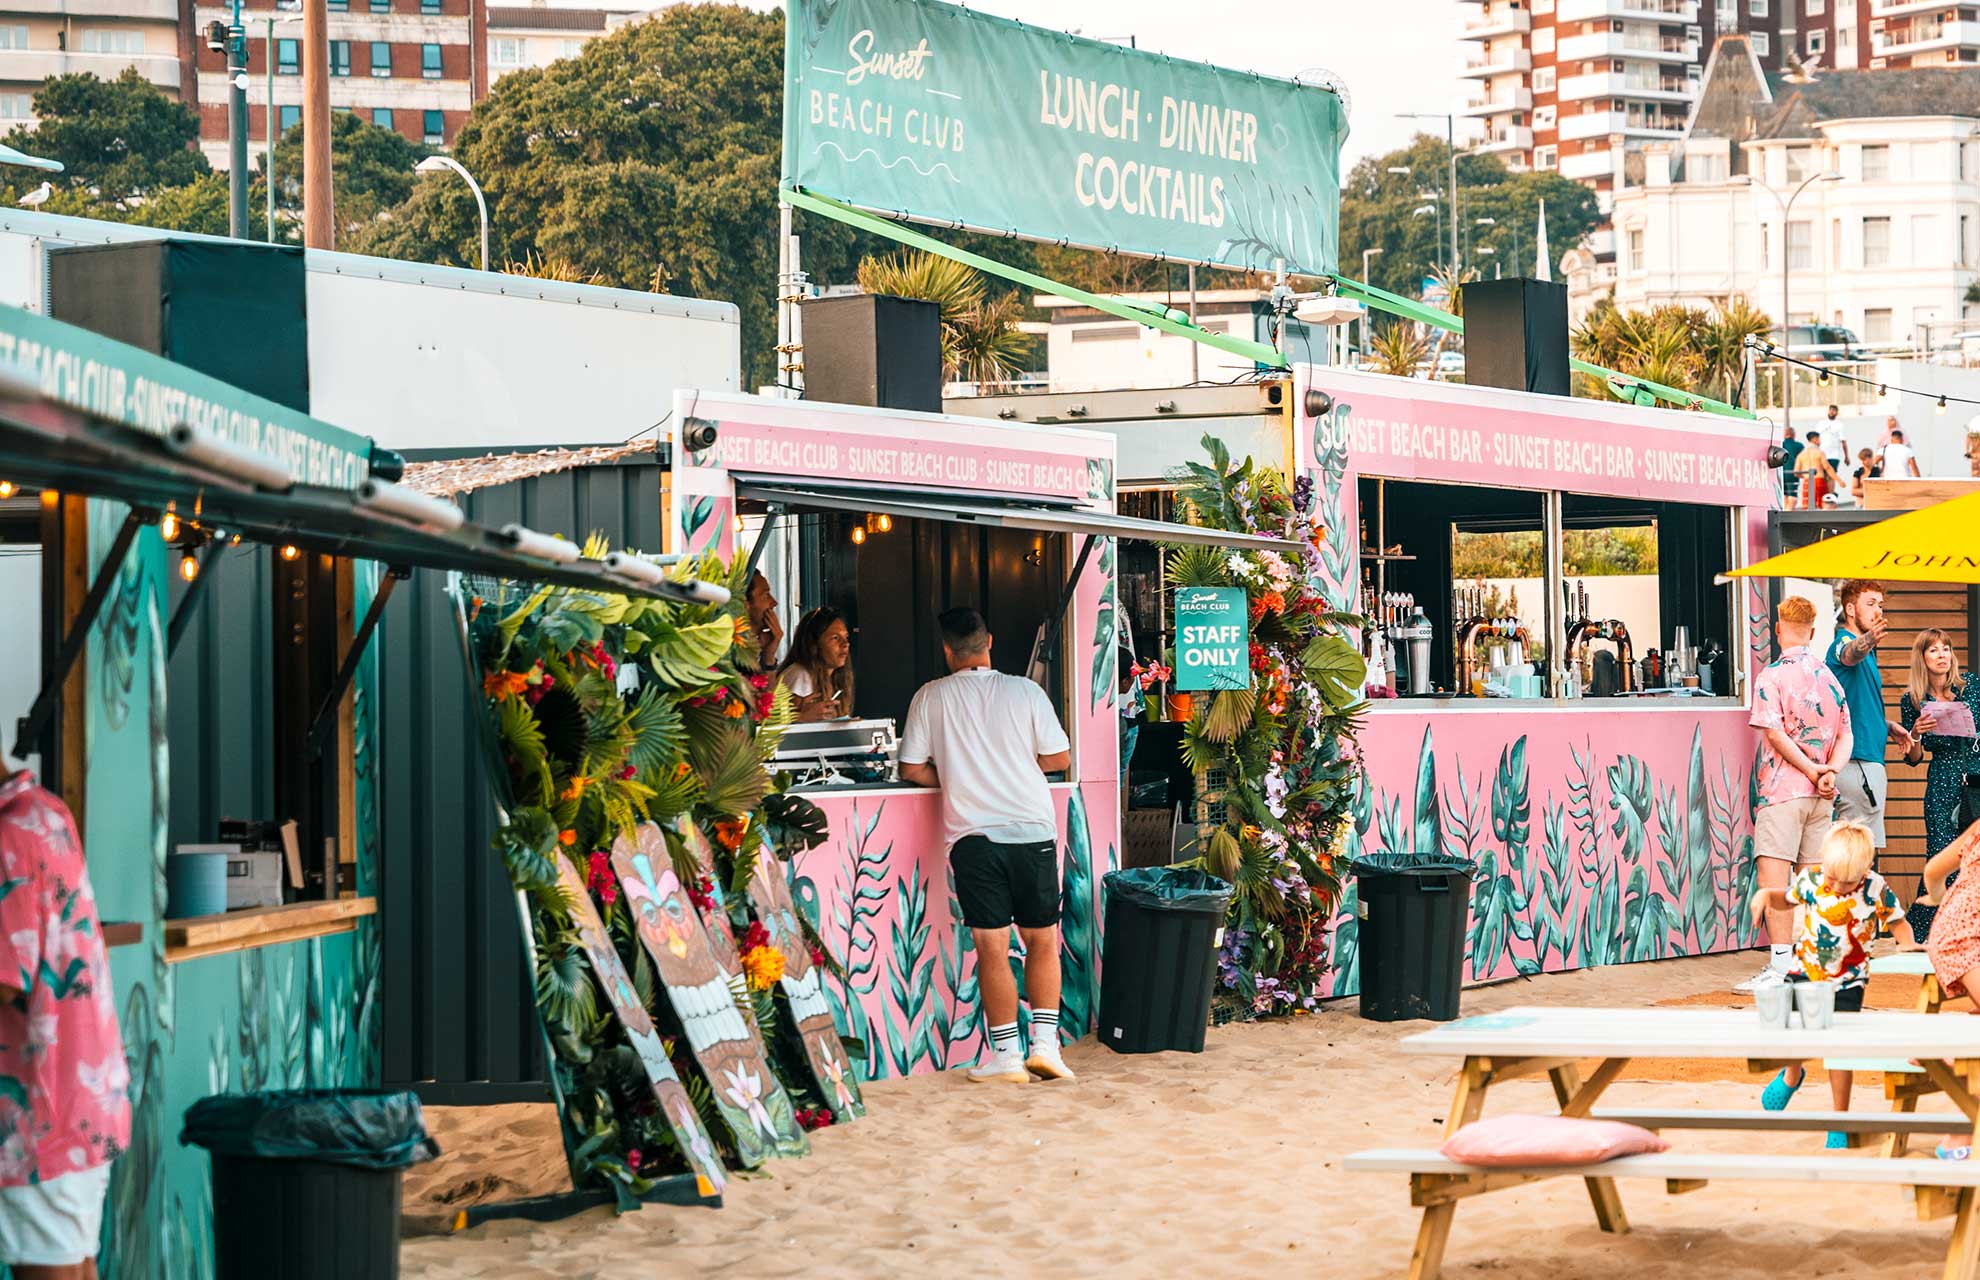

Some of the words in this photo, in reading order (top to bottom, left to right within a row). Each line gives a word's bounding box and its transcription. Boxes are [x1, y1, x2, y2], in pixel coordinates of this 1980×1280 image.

[846, 29, 934, 87] Sunset
[809, 90, 893, 139] BEACH
[904, 108, 965, 153] CLUB
[1040, 70, 1139, 143] LUNCH
[1158, 96, 1258, 165] DINNER
[1074, 152, 1225, 230] COCKTAILS
[754, 438, 800, 467] BEACH
[802, 443, 839, 470] CLUB
[848, 447, 898, 475] SUNSET
[901, 451, 943, 479] BEACH
[946, 455, 978, 482] CLUB
[986, 459, 1031, 486] SUNSET
[1033, 464, 1073, 491] BEACH
[1318, 414, 1387, 455] SUNSET
[1390, 421, 1446, 461] BEACH
[1449, 427, 1483, 464] BAR
[1494, 432, 1550, 471] SUNSET
[1553, 439, 1603, 476] BEACH
[1606, 444, 1635, 479] BAR
[1644, 448, 1696, 485] SUNSET
[1699, 454, 1741, 488] BEACH
[1744, 459, 1770, 490] BAR
[1181, 603, 1207, 611] BEACH
[1210, 603, 1230, 611] CLUB
[1183, 625, 1241, 644] STAFF
[1184, 648, 1240, 667] ONLY
